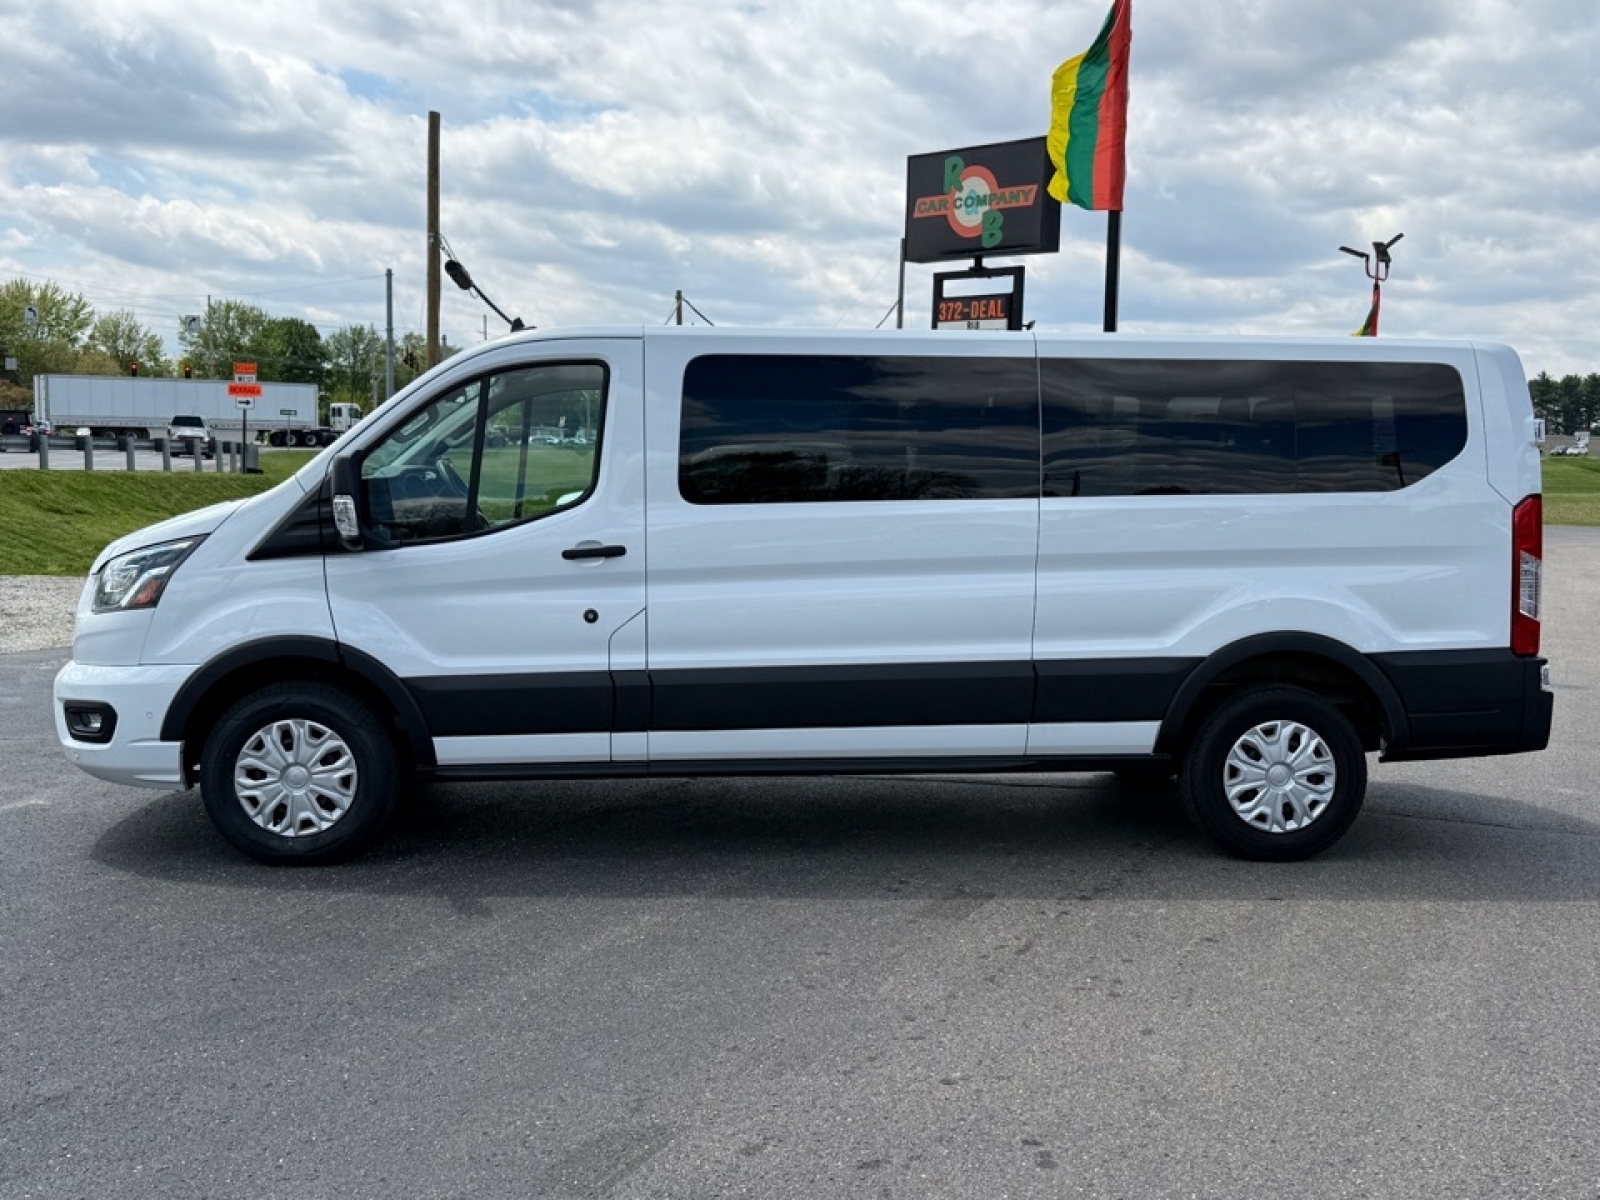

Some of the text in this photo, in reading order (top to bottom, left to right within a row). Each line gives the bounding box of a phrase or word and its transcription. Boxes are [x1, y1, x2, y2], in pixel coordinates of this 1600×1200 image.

[944, 156, 963, 194] R
[917, 189, 1033, 213] CAR COMPANY
[982, 210, 1003, 247] B
[939, 300, 1004, 320] 372-DEAL
